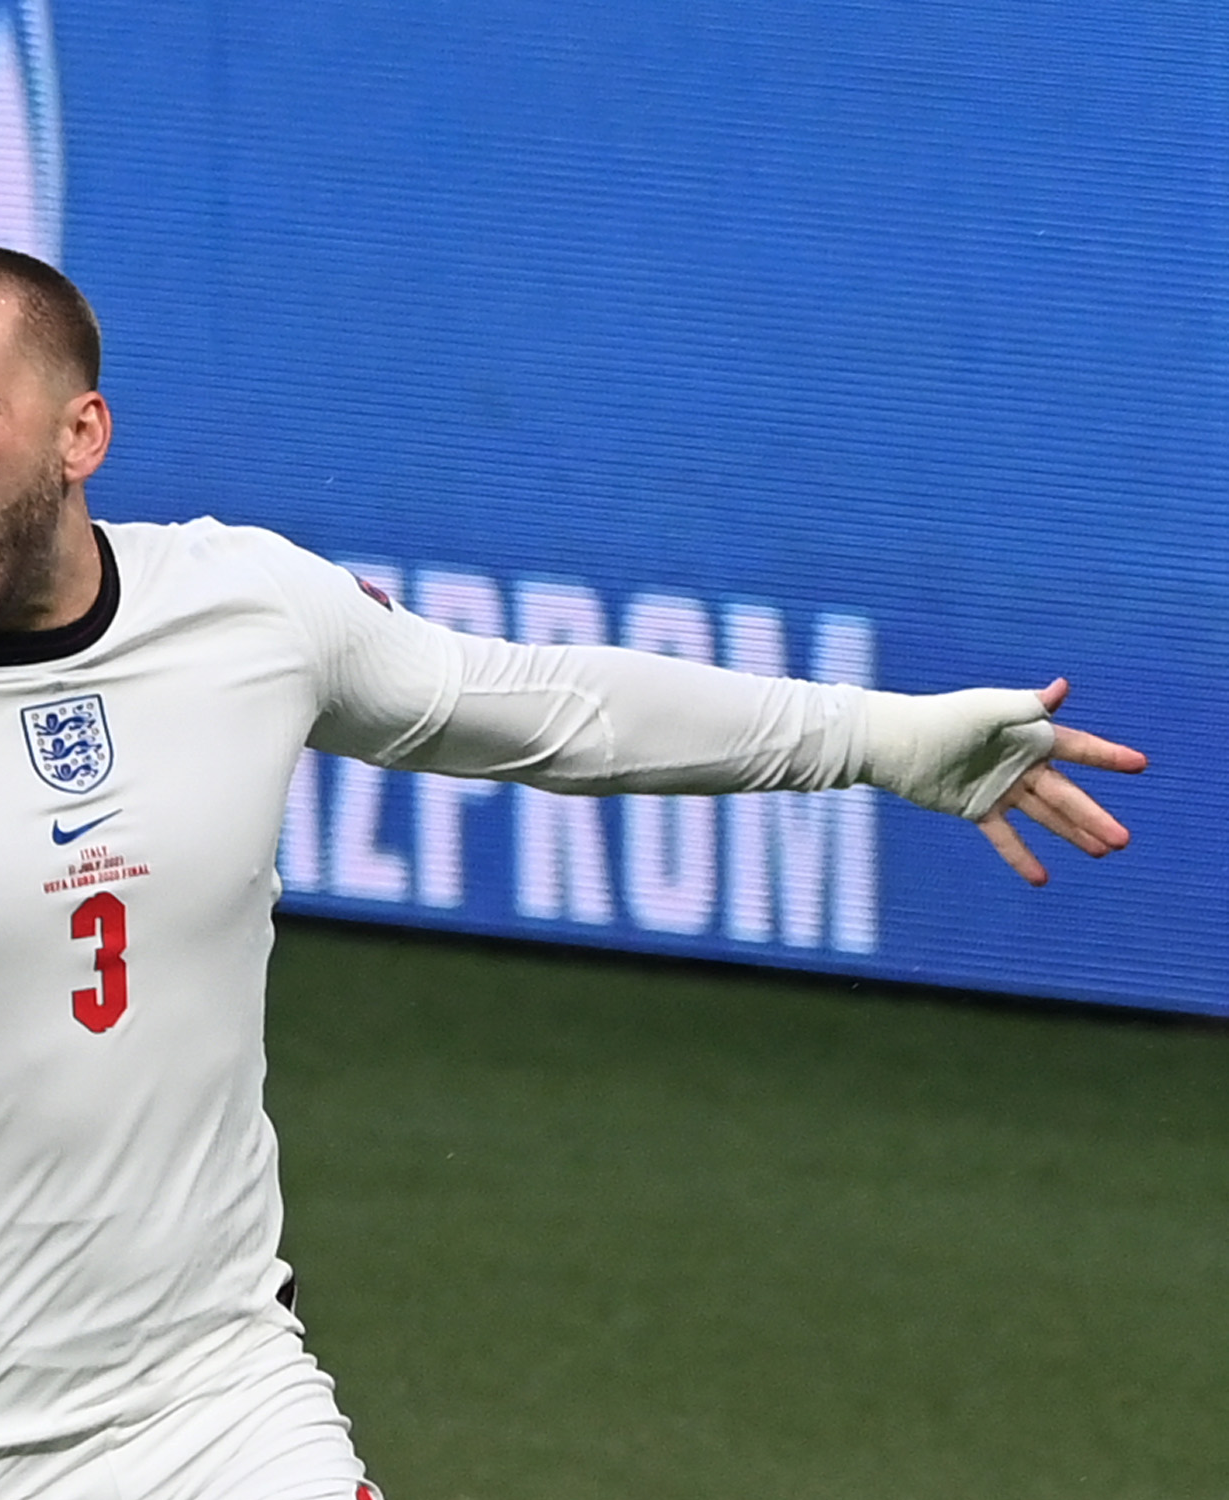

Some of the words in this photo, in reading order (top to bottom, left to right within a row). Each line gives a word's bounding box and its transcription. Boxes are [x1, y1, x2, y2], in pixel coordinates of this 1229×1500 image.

[276, 553, 874, 954] ZPROM
[78, 861, 101, 874] JULY
[103, 856, 124, 869] 2021
[80, 846, 108, 860] ITALY
[43, 878, 68, 894] UEFA
[71, 873, 95, 889] EURO
[98, 869, 120, 883] 2020
[121, 864, 150, 879] FINAL
[71, 891, 128, 1034] 3
